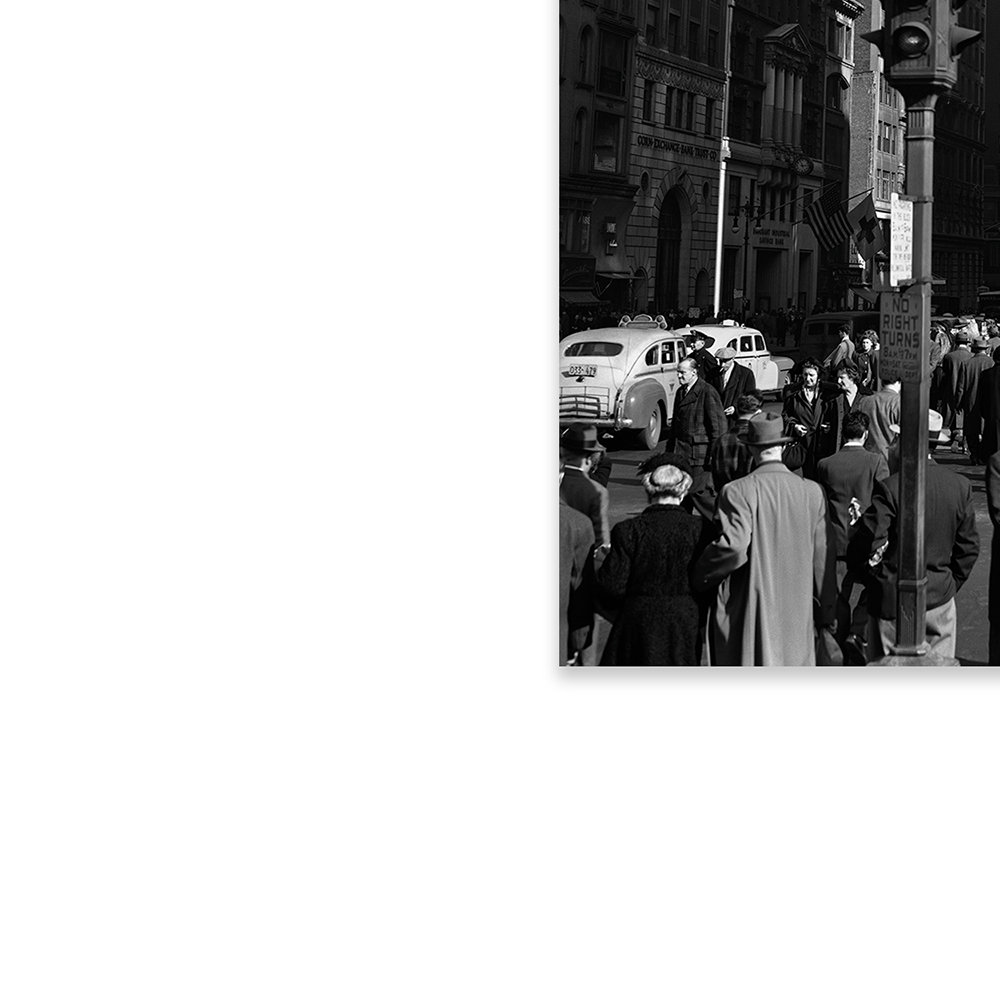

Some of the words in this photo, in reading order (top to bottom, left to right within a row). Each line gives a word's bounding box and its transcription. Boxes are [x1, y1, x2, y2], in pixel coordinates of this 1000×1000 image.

[892, 298, 909, 313] NO
[883, 314, 919, 331] RIGHT
[882, 331, 920, 349] TURNS
